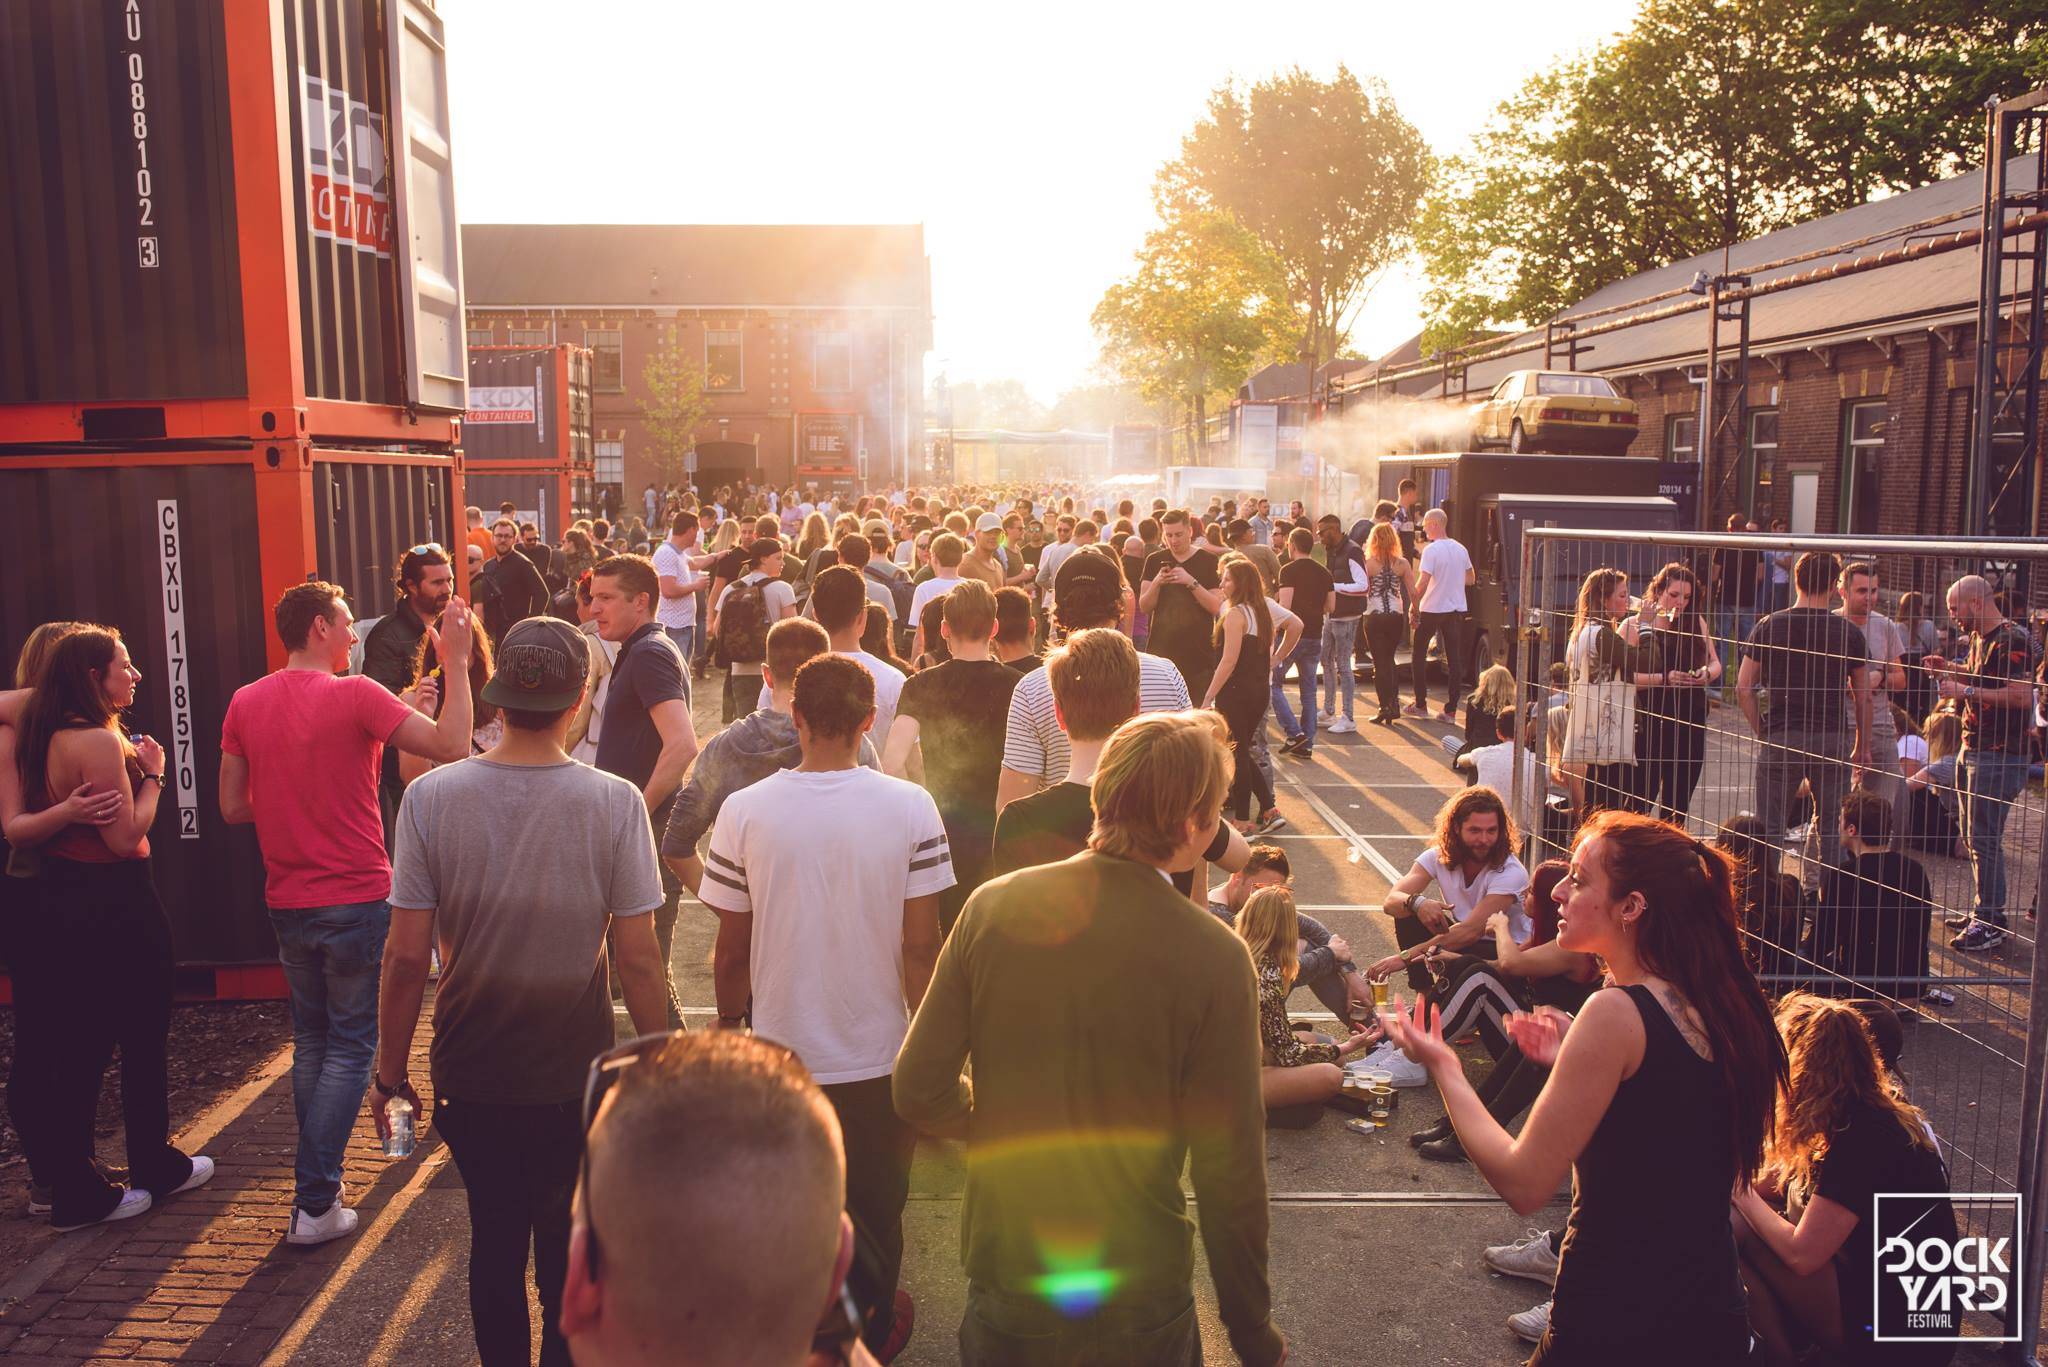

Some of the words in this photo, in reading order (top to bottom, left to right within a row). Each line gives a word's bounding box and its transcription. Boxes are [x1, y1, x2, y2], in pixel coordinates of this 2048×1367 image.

[128, 53, 153, 226] 088102
[141, 239, 156, 266] 3
[468, 411, 530, 421] CONTAINERS
[163, 506, 180, 613] CBXU
[171, 630, 192, 790] 178570
[182, 809, 195, 833] 2
